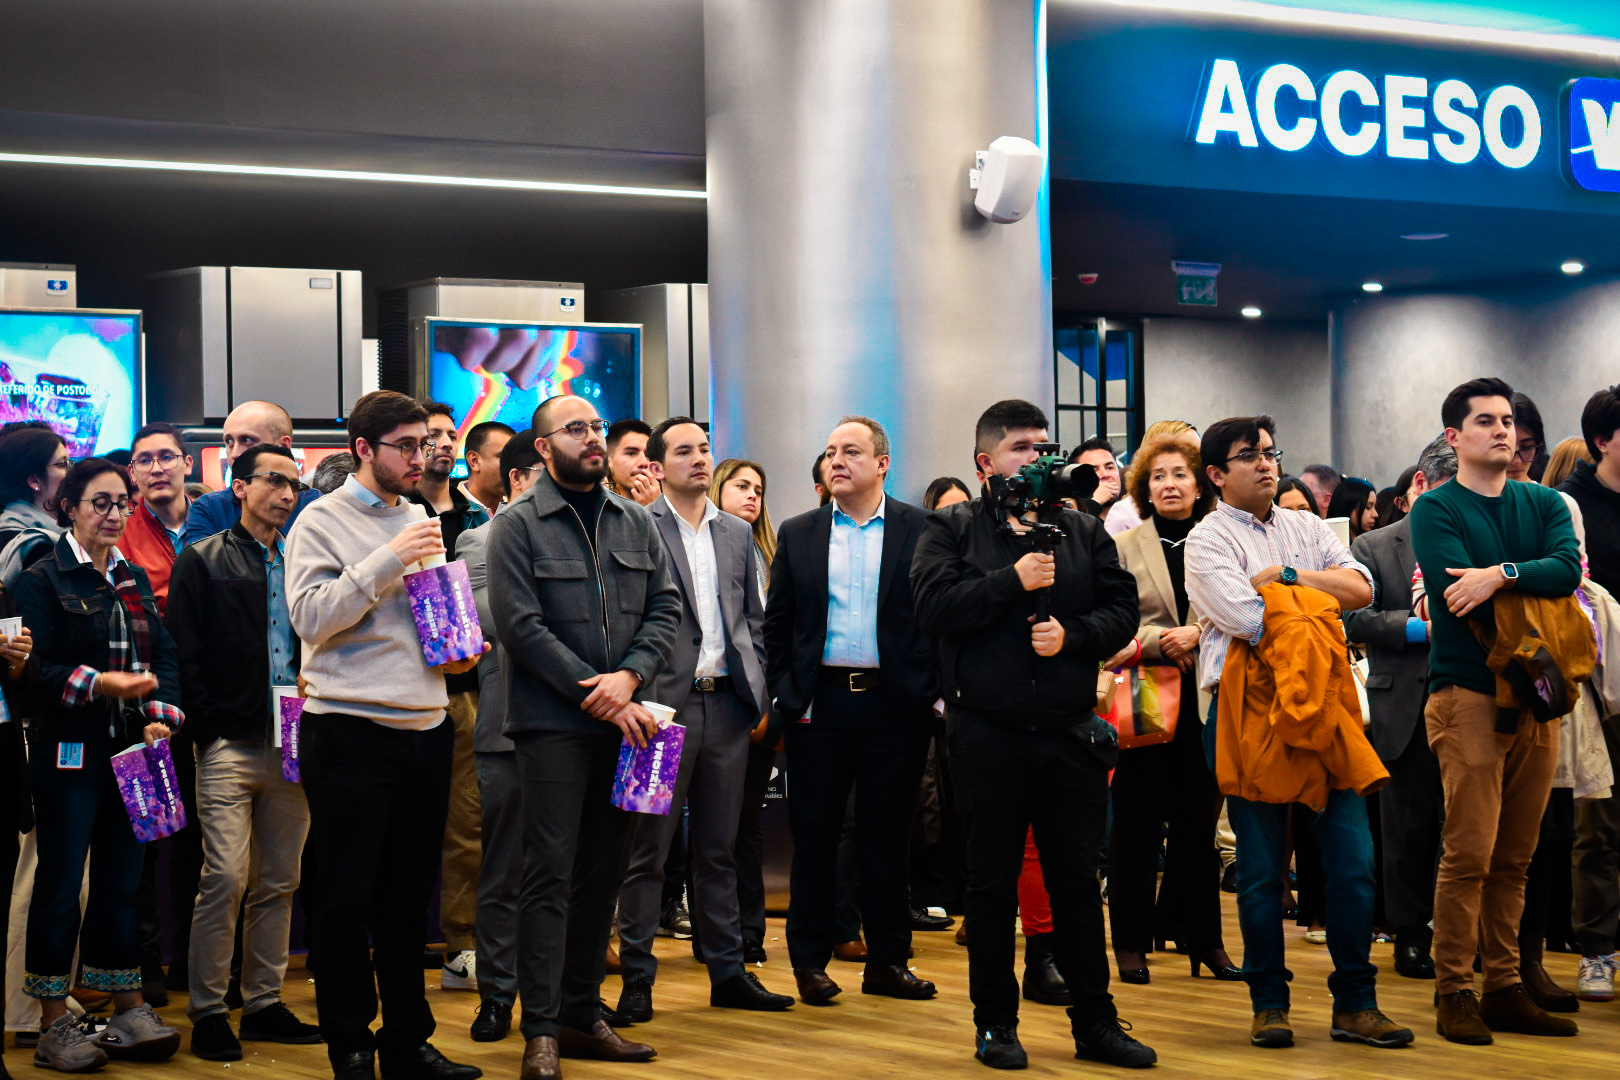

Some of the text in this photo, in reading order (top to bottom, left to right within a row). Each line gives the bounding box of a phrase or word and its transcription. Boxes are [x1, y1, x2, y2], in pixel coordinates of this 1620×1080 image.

[1195, 59, 1542, 168] ACCESO
[42, 384, 55, 394] DE
[423, 597, 439, 638] VIZIONA
[454, 580, 472, 639] VIZIONA
[158, 759, 176, 815] VIZIONA
[647, 741, 665, 796] VIZIONA
